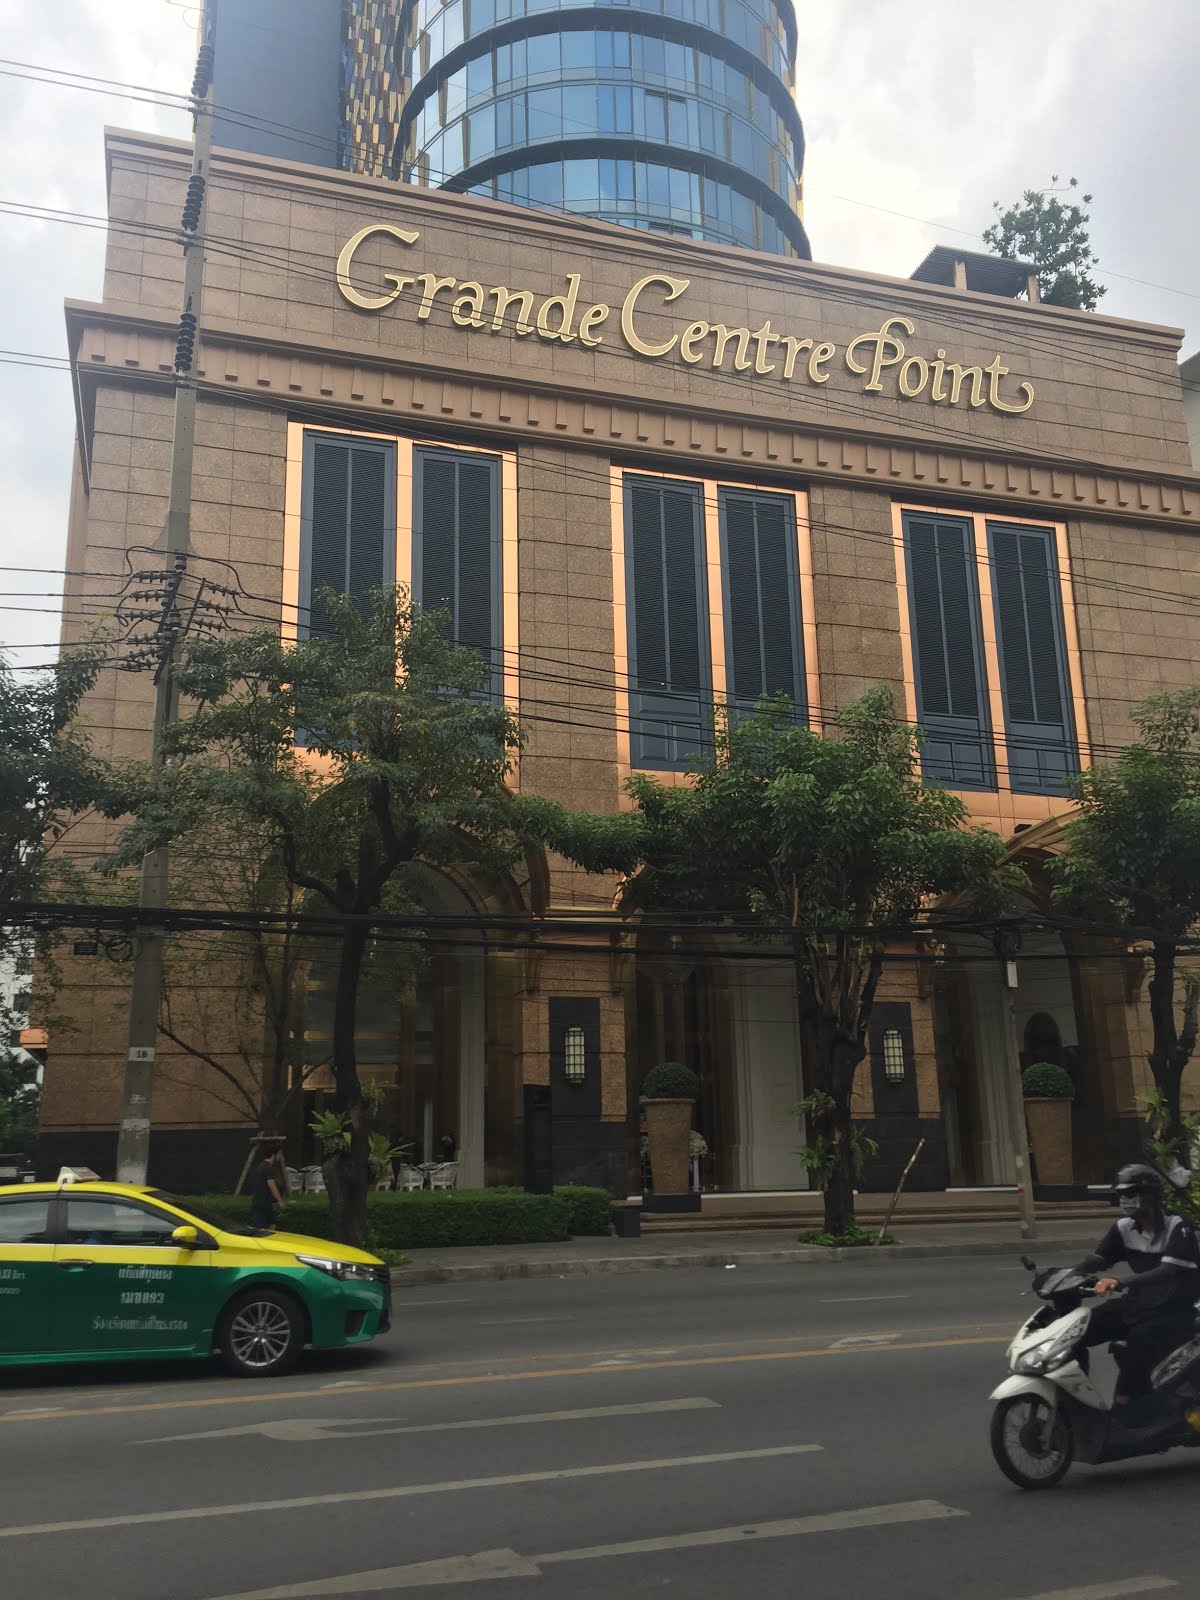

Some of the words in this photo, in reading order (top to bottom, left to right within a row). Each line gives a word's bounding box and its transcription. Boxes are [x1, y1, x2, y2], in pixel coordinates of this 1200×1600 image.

[337, 224, 610, 347] Grande
[621, 274, 836, 384] Centre
[846, 317, 1035, 414] Point
